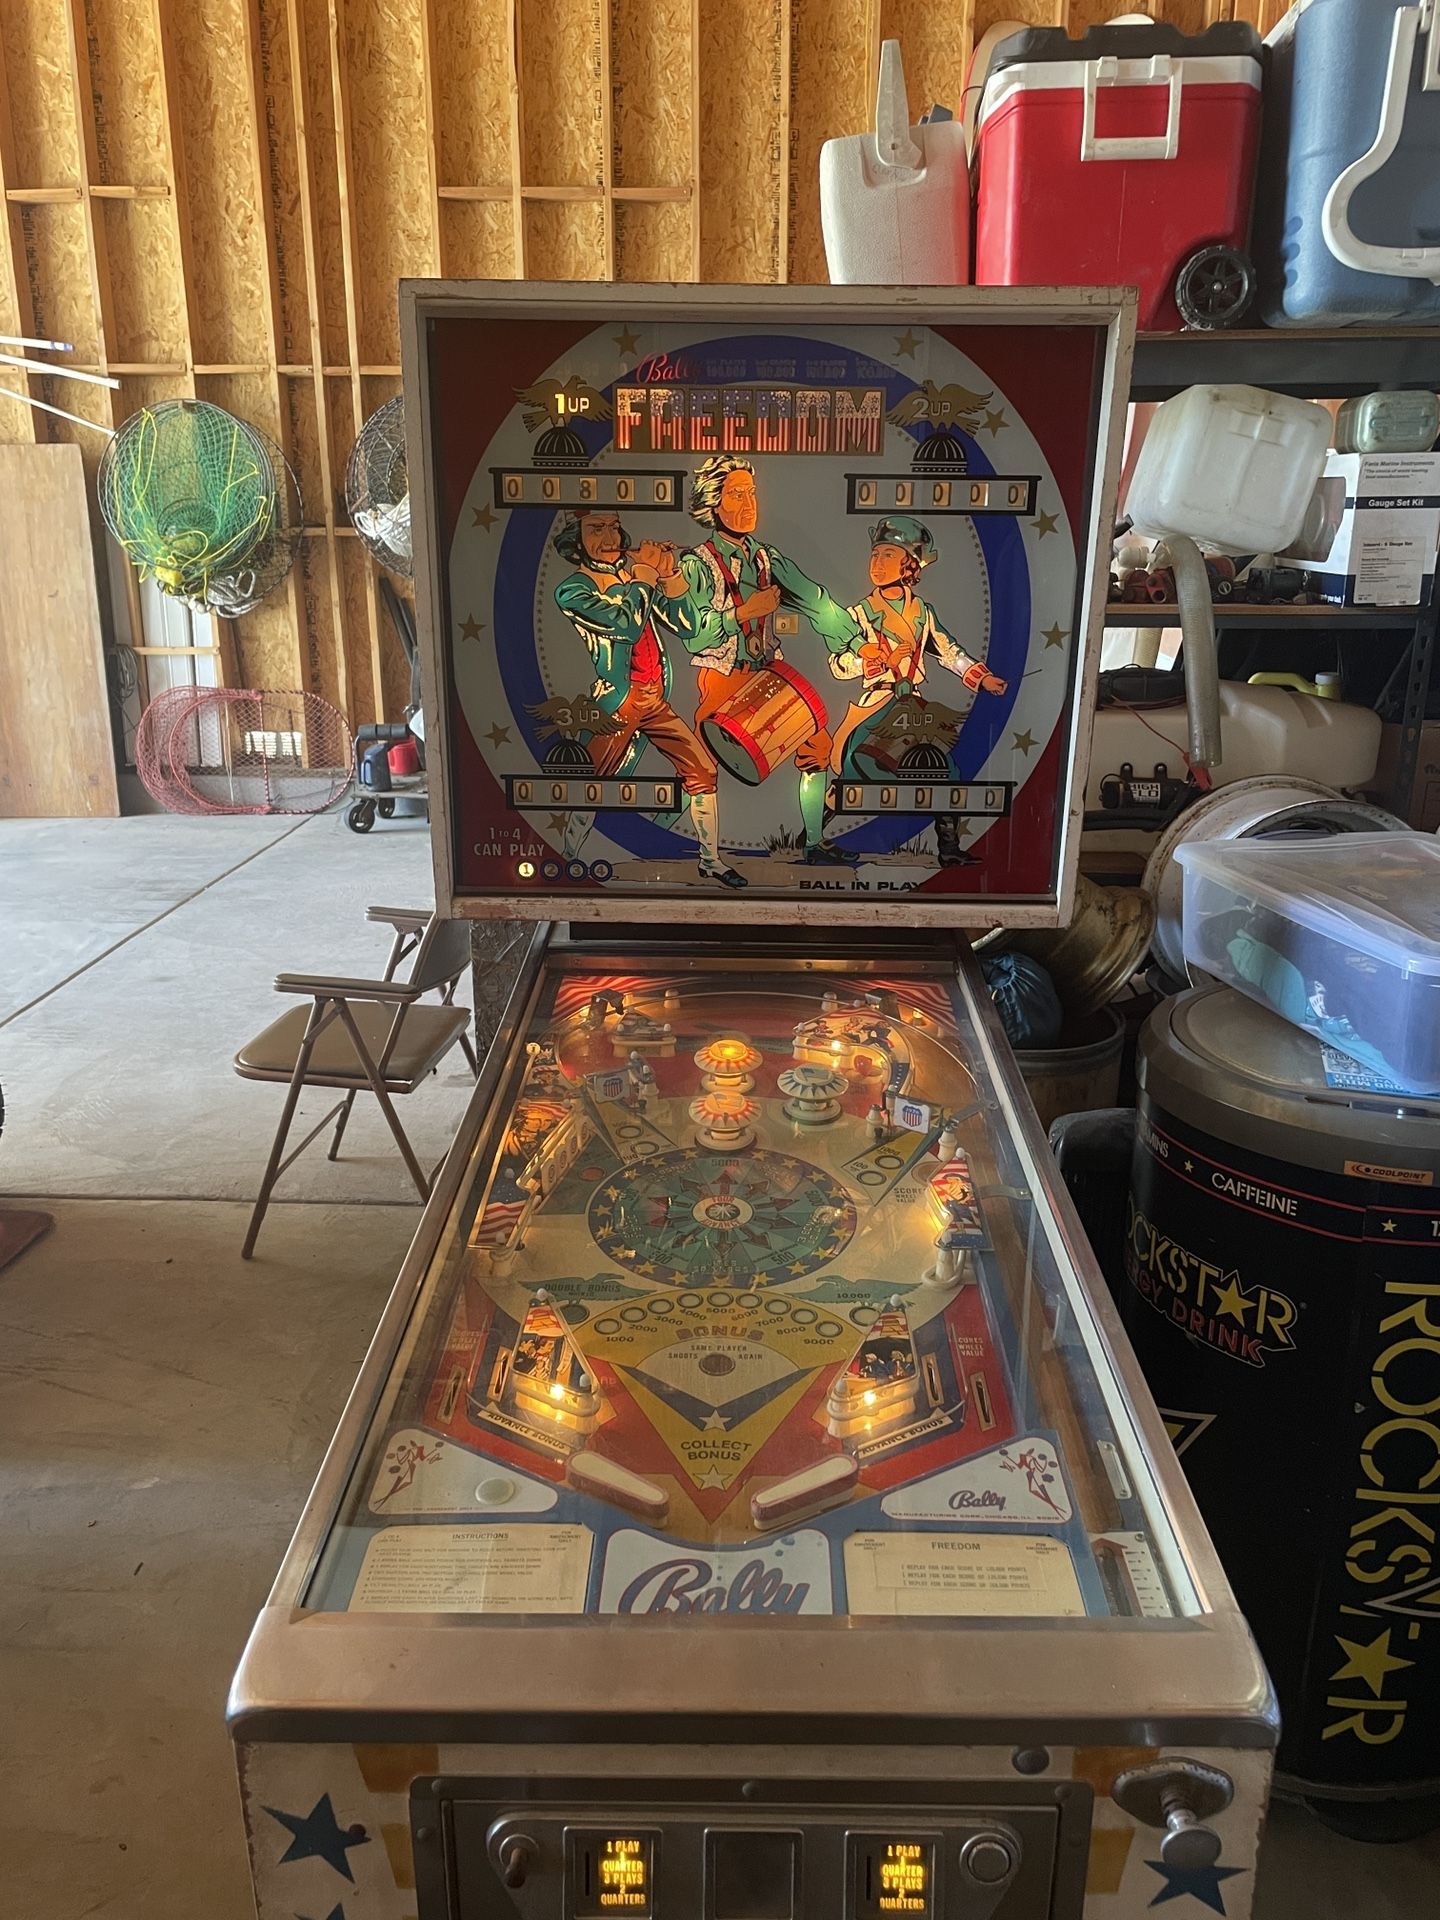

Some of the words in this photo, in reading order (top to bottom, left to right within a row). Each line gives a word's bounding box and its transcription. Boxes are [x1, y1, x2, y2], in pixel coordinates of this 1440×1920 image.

[615, 387, 882, 452] FREEDOM
[1368, 499, 1395, 508] Gauge
[1412, 498, 1424, 506] Kit
[512, 827, 521, 838] 4
[474, 843, 502, 857] CAN
[509, 843, 545, 857] PLAY
[799, 880, 845, 890] BALL
[851, 880, 870, 890] IN
[877, 880, 922, 892] PLAY
[1334, 1078, 1371, 1087] MILK
[852, 1161, 868, 1170] 100
[1212, 1172, 1298, 1216] CAFFEINE
[770, 1251, 797, 1265] 500
[588, 1283, 621, 1293] BONUS
[679, 1308, 707, 1320] 4000
[731, 1309, 758, 1321] 6000
[654, 1316, 683, 1326] 3000
[755, 1316, 783, 1327] 7000
[629, 1324, 658, 1333] 2000
[675, 1325, 764, 1340] BONUS
[776, 1326, 806, 1335] 8000
[1172, 1297, 1263, 1361] DRINK
[488, 1412, 531, 1434] ADVANCE
[533, 1430, 566, 1450] BONUS
[862, 1433, 907, 1455] ADVANCE
[910, 1417, 944, 1439] BONUS
[680, 1440, 752, 1451] COLLECT
[687, 1450, 742, 1461] BONUS
[948, 1490, 1007, 1511] Bally
[1321, 1281, 1440, 1745] ROCKSR
[452, 1532, 509, 1540] INSTRUCTIONS
[931, 1541, 981, 1550] FREEDOM
[618, 1558, 810, 1614] Bally
[607, 1841, 612, 1853] 1
[615, 1840, 640, 1853] PLAY
[887, 1845, 893, 1857] 1
[896, 1845, 921, 1857] PLAY
[602, 1860, 644, 1872] QUARTER
[882, 1864, 924, 1877] QUARTER
[604, 1872, 610, 1884] 3
[613, 1872, 643, 1885] PLAYS
[883, 1877, 889, 1888] 3
[892, 1877, 923, 1889] PLAYS
[620, 1884, 626, 1894] 2
[899, 1888, 905, 1898] 2
[600, 1893, 646, 1905] QUARTERS
[880, 1897, 925, 1909] QUARTERS
